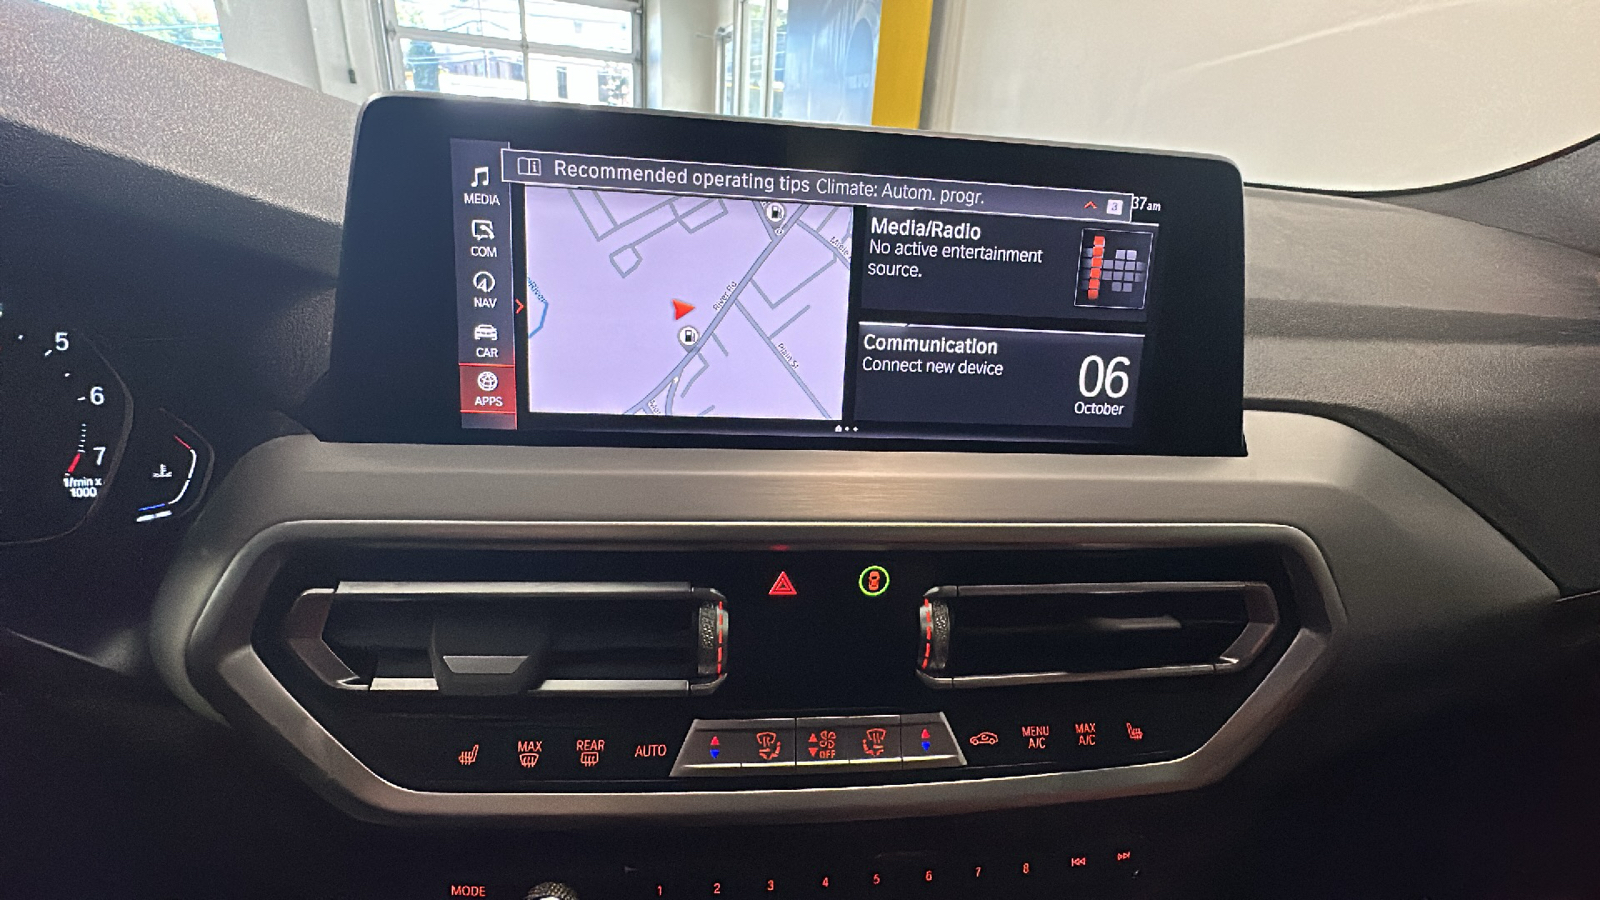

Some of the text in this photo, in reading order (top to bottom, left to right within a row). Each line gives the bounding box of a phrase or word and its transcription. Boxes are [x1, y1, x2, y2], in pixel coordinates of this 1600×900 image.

[554, 159, 985, 208] Recommended operating tips Climate: Autom. progr.
[463, 192, 501, 206] MEDIA
[870, 216, 981, 242] Media/Radio
[470, 246, 498, 258] COM
[869, 240, 1044, 264] No active entertainment
[867, 262, 923, 278] source.
[473, 296, 498, 309] NAV
[55, 332, 70, 351] 5
[863, 333, 998, 356] Communication
[476, 347, 499, 358] CAR
[862, 356, 1004, 376] Connect new device
[1078, 354, 1131, 399] 06
[89, 386, 105, 406] 6
[475, 396, 503, 407] APPS
[1074, 401, 1125, 416] October
[93, 446, 107, 466] 7
[69, 487, 98, 498] 1000
[1021, 725, 1050, 738] MENU
[1075, 722, 1096, 734] MAX
[517, 740, 543, 752] MAX
[576, 739, 606, 751] REAR
[1028, 737, 1046, 749] A/C
[1078, 734, 1096, 746] A/C
[634, 744, 667, 758] AUTO
[819, 750, 836, 759] OFF
[975, 866, 982, 878] 7
[1022, 862, 1030, 874] 8
[822, 876, 829, 888] 4
[873, 873, 881, 885] 5
[925, 870, 933, 882] 6
[451, 885, 486, 897] MODE
[713, 882, 721, 894] 2
[767, 879, 774, 891] 3
